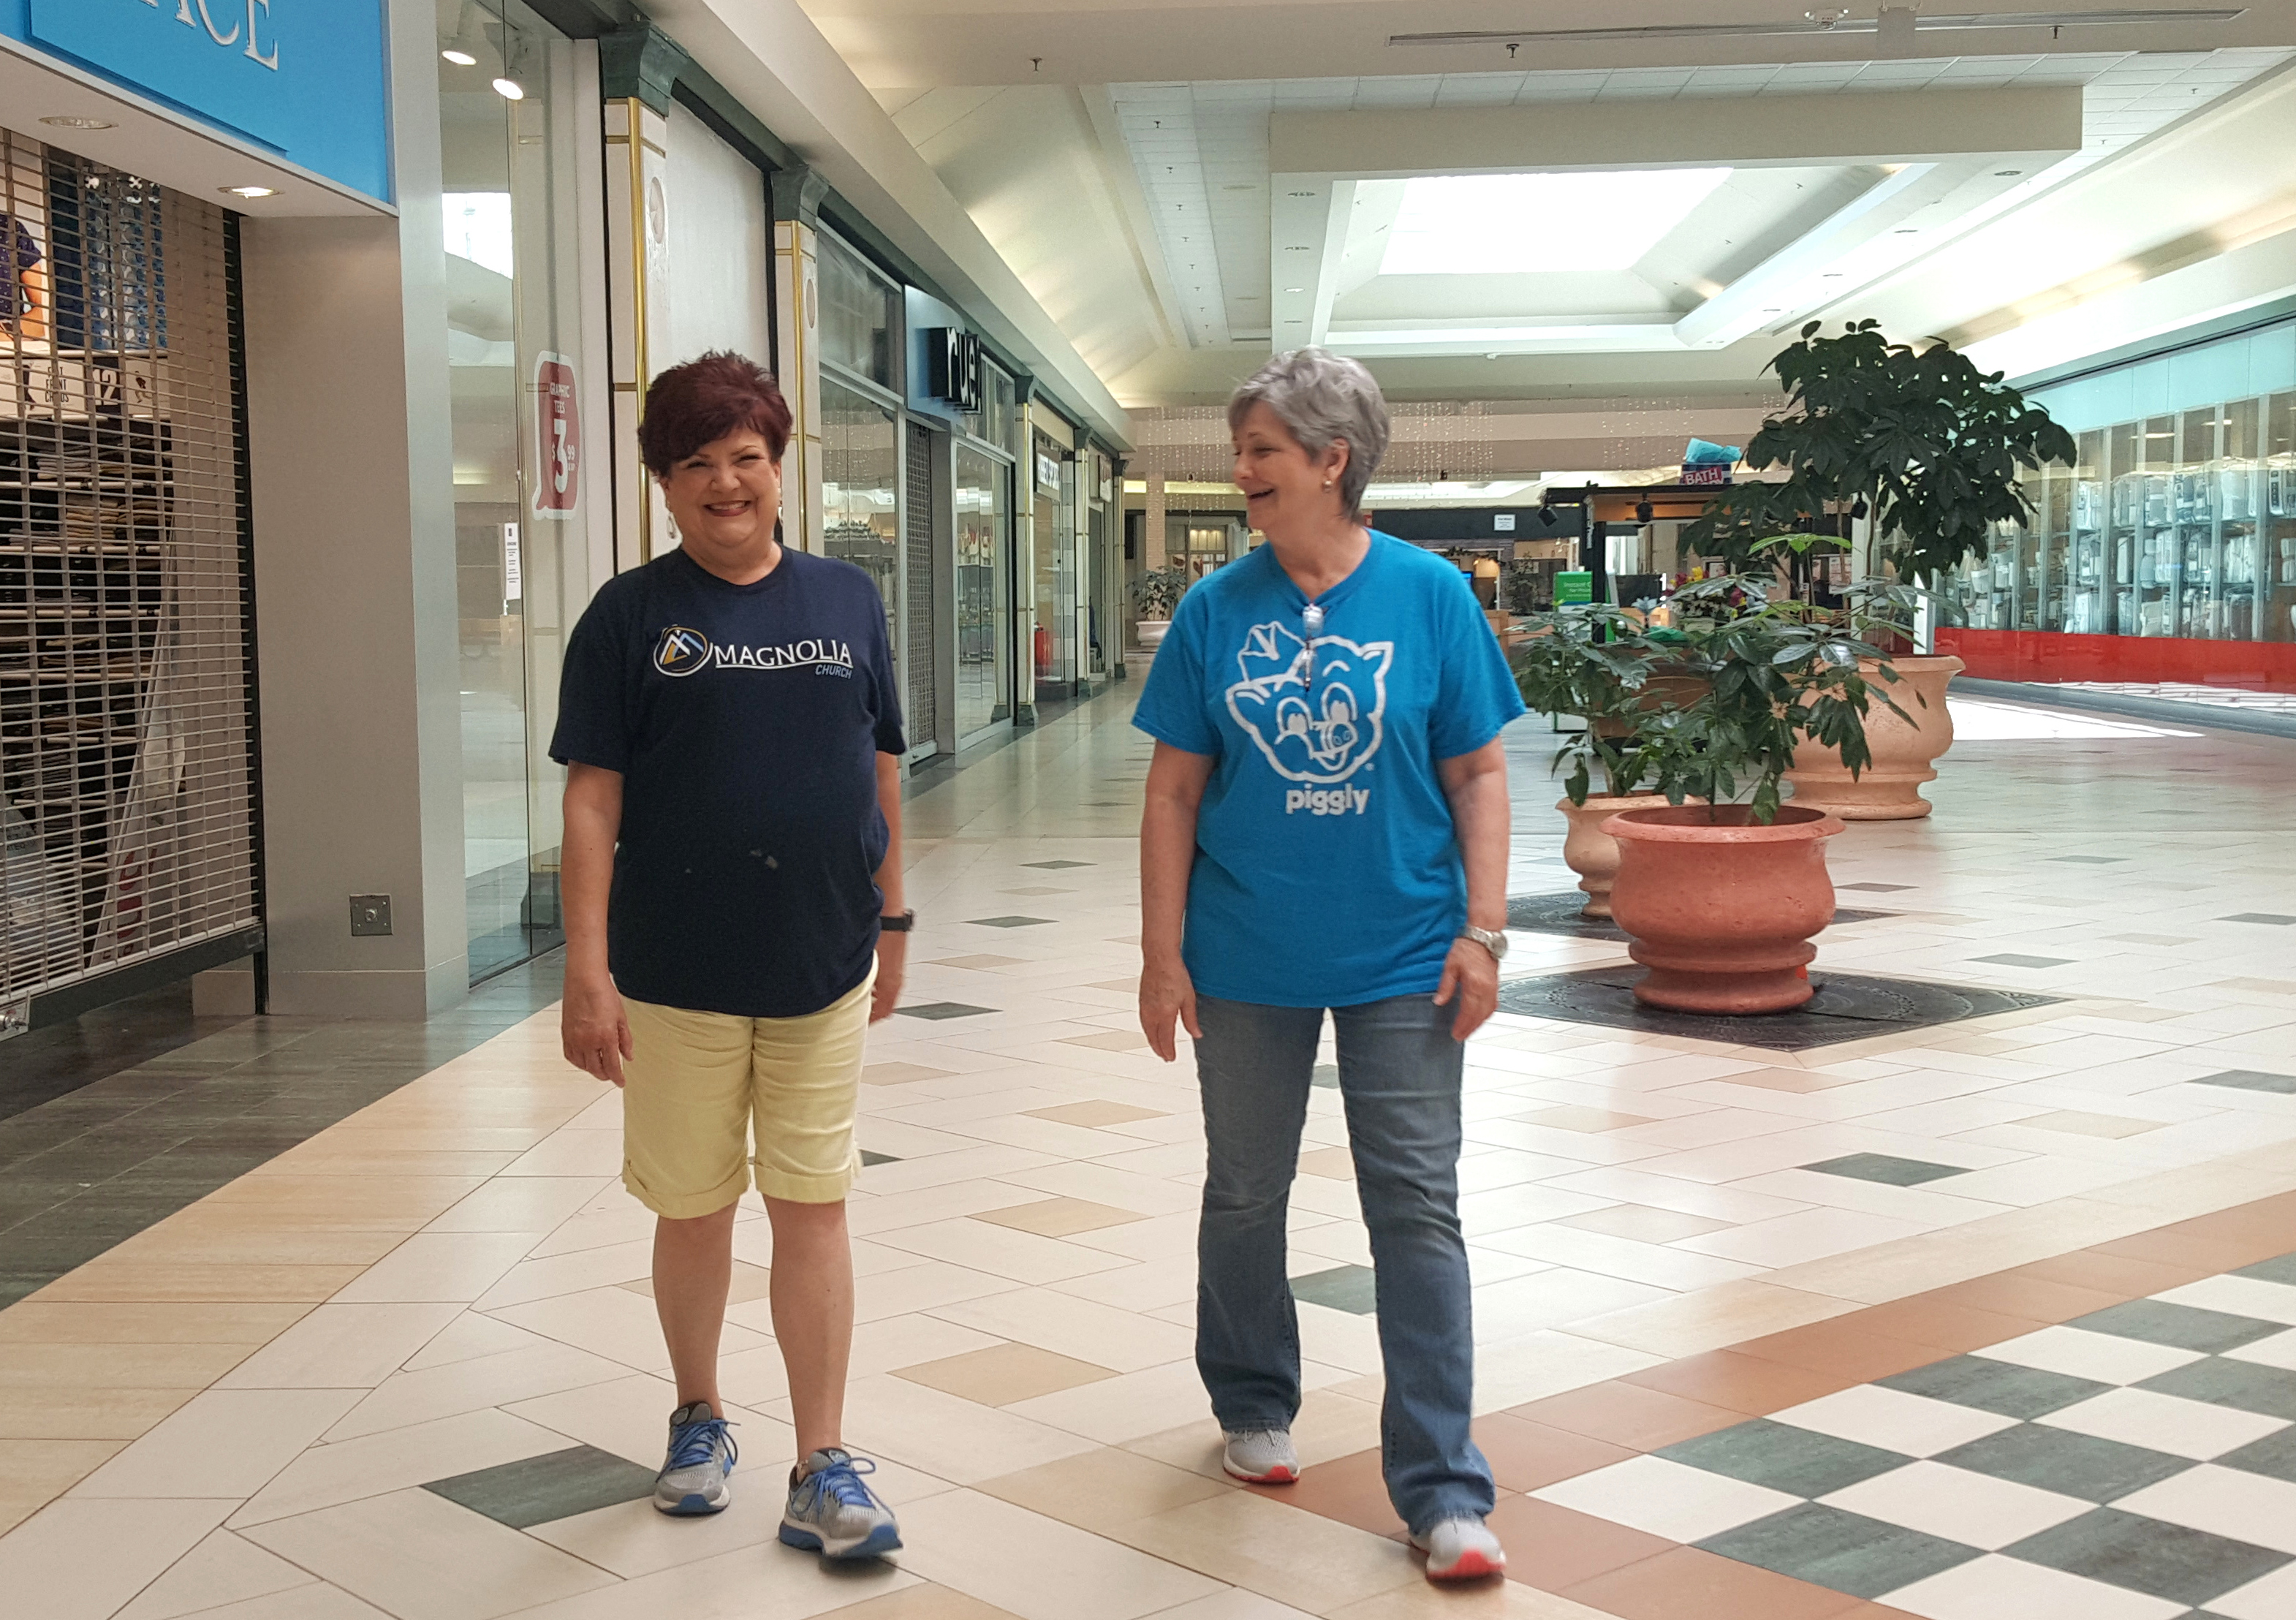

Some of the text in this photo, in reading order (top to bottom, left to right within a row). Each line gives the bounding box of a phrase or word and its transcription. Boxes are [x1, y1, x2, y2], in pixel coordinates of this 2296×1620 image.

[92, 368, 118, 406] 12
[1685, 468, 1719, 485] BATH
[713, 639, 853, 667] MAGNOLIA
[815, 663, 853, 680] CHURCH
[1285, 782, 1371, 816] piggly
